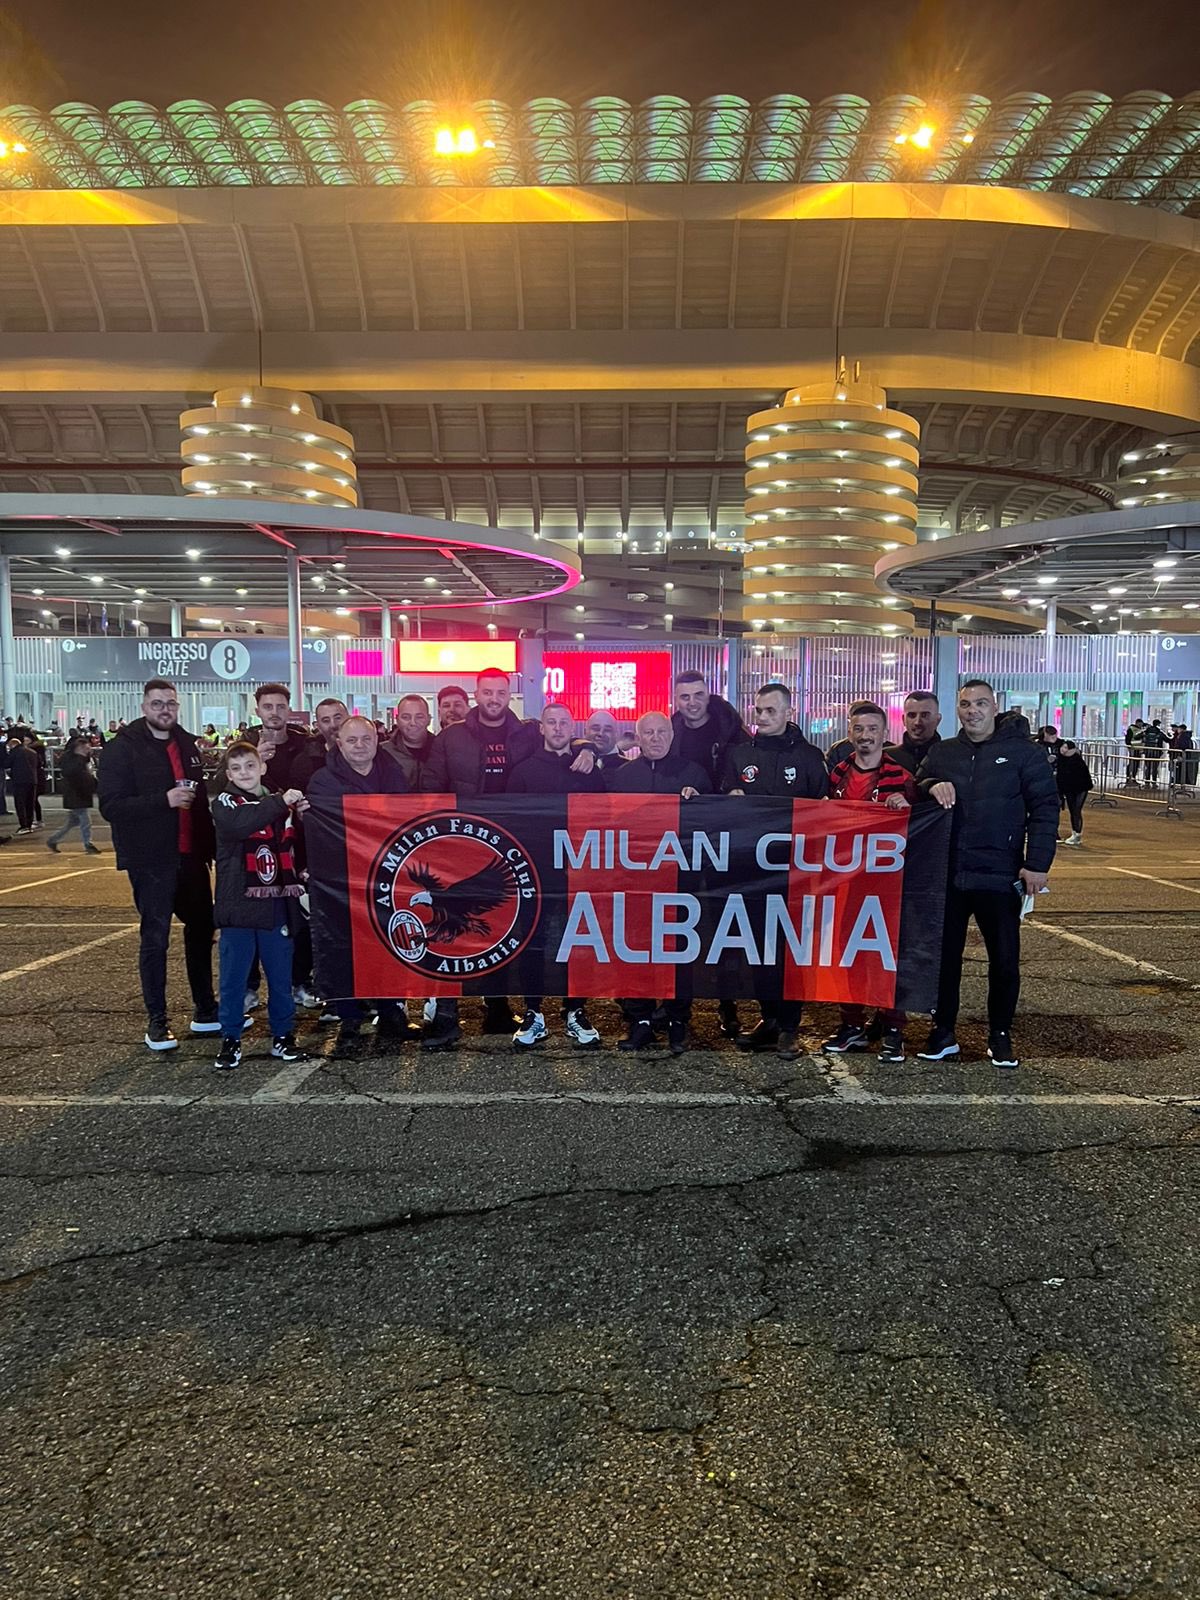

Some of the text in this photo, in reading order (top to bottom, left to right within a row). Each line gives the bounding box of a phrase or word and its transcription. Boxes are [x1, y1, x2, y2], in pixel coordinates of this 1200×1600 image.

[137, 642, 208, 660] INGRESSO
[157, 660, 190, 676] GATE
[224, 645, 237, 674] 8
[376, 819, 537, 907] Ac Milan Fans Club
[553, 829, 907, 873] MILAN CLUB
[555, 891, 897, 972] ALBANIA
[437, 937, 520, 973] Albania
